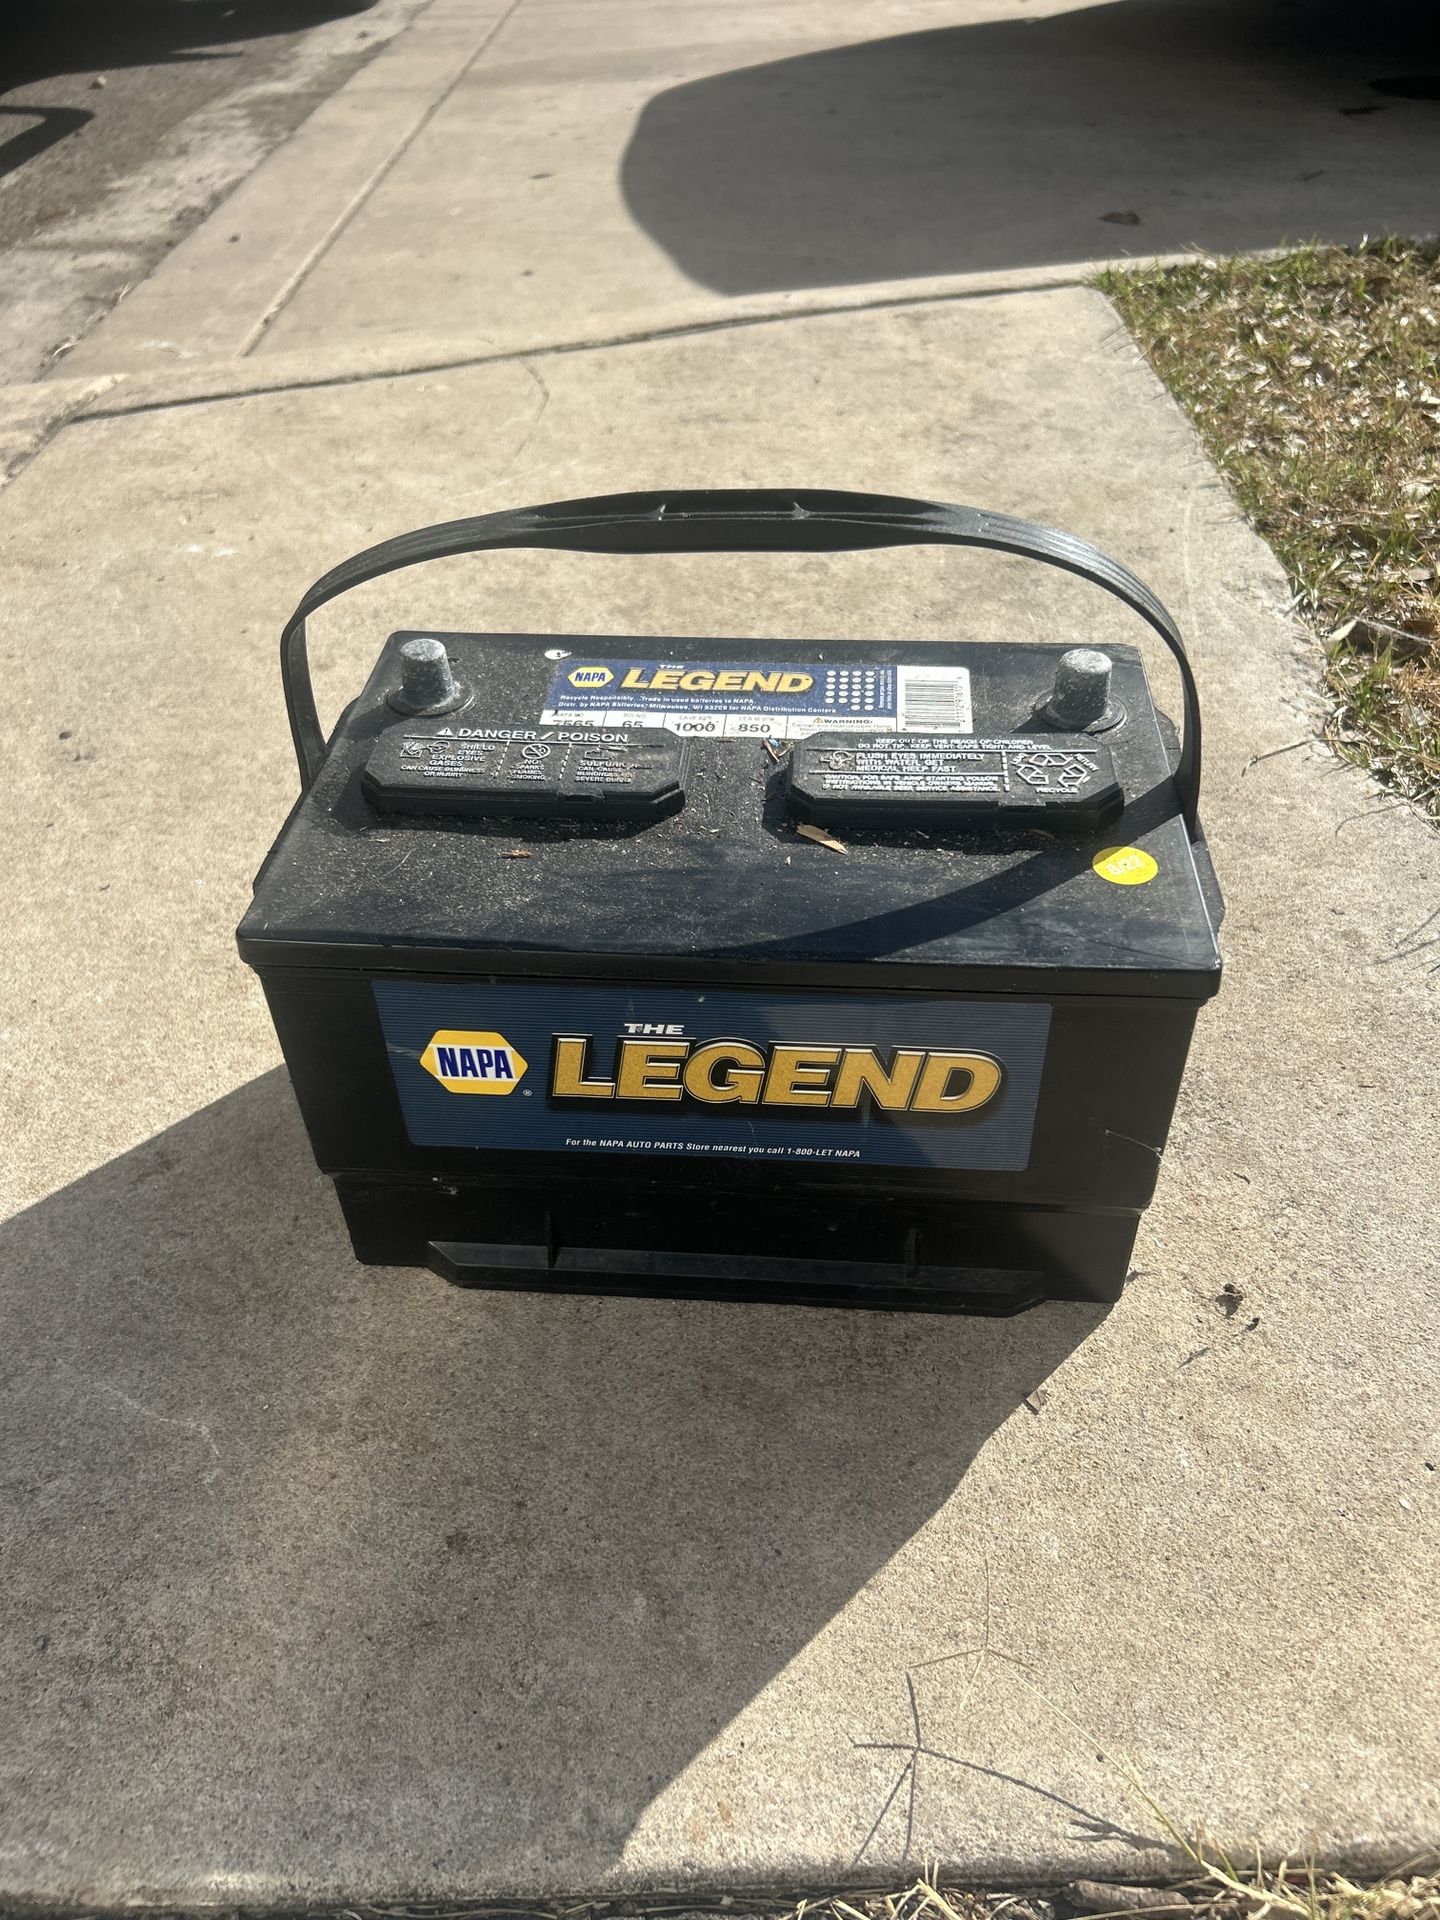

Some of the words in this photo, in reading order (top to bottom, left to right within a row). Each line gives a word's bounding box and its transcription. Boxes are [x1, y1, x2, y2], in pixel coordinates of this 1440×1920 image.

[574, 671, 606, 683] NAPA
[619, 667, 815, 692] LEGEND
[622, 720, 645, 728] 65
[738, 724, 771, 732] 850
[457, 728, 537, 740] DANGER
[557, 731, 629, 742] POISON
[431, 754, 486, 762] EXPLOSIVE
[624, 1023, 685, 1035] THE
[437, 1047, 513, 1079] NAPA
[551, 1034, 1003, 1113] LEGEND
[566, 1138, 581, 1146] For
[626, 1141, 652, 1149] AUTO
[654, 1142, 684, 1150] PARTS
[686, 1143, 710, 1151] Store
[712, 1144, 747, 1152] nearest
[748, 1146, 764, 1154] you
[767, 1146, 784, 1154] call
[787, 1148, 833, 1156] 1-800-LET
[835, 1149, 860, 1157] NAPA
